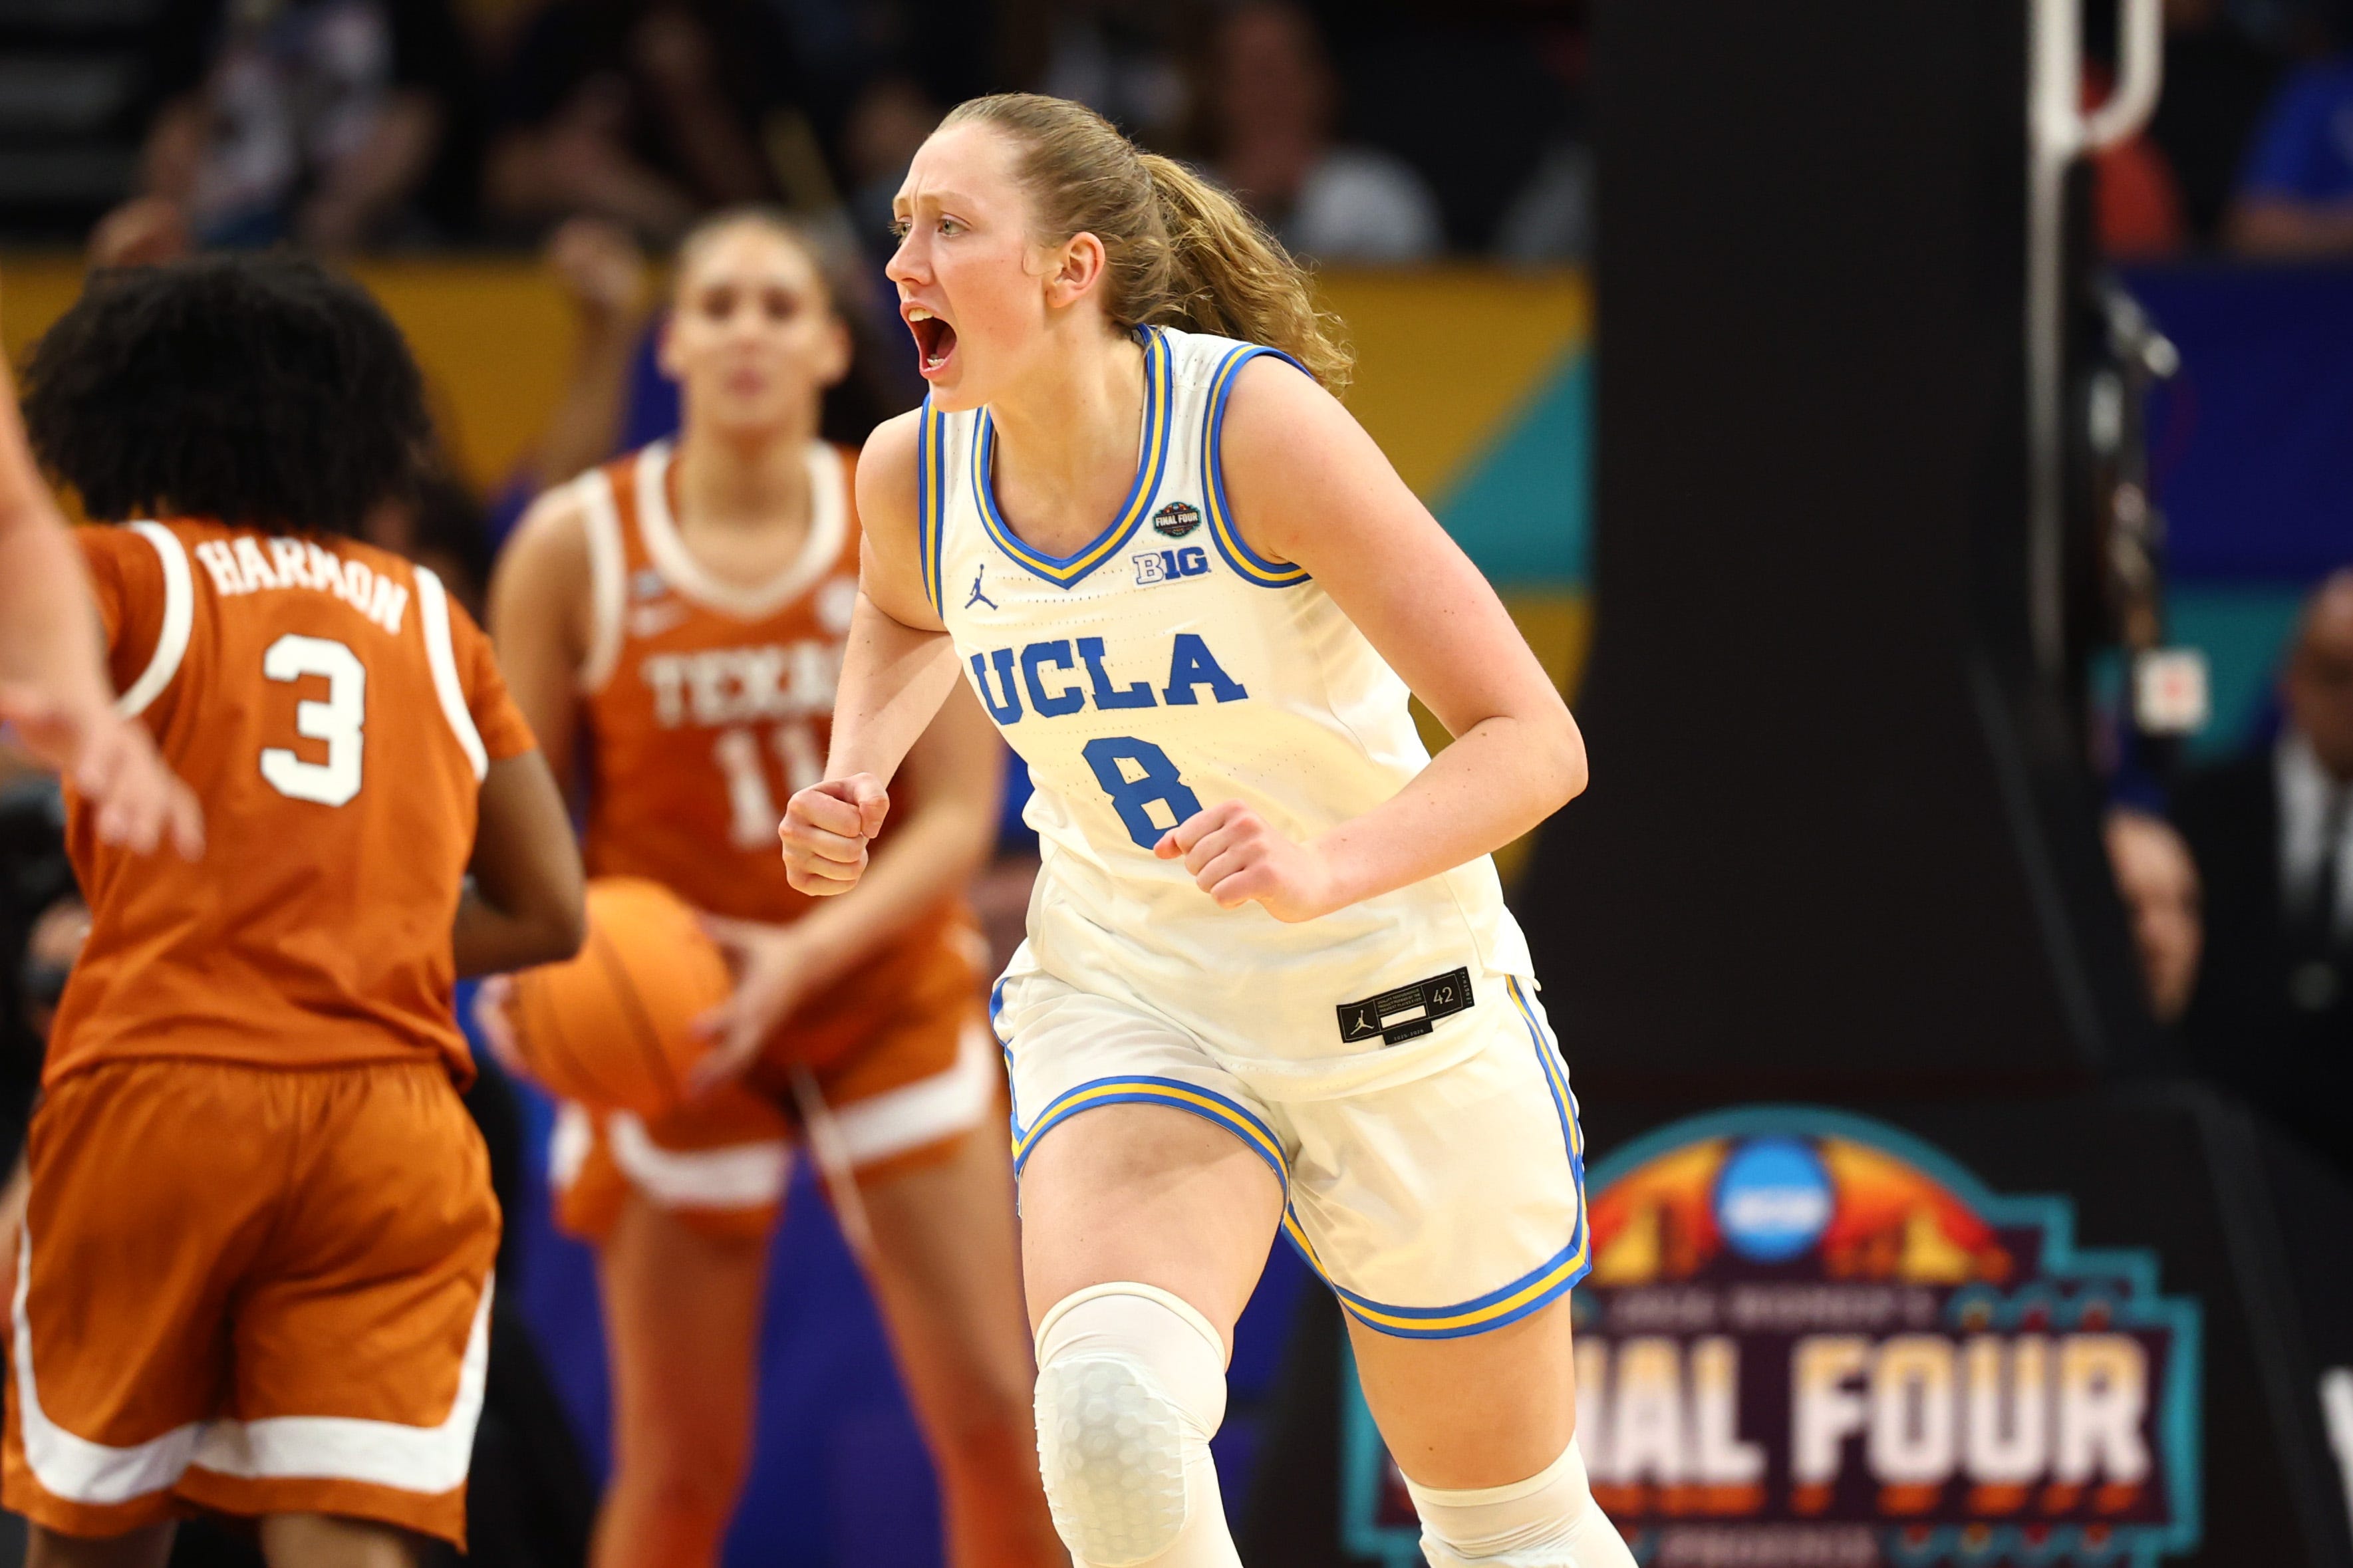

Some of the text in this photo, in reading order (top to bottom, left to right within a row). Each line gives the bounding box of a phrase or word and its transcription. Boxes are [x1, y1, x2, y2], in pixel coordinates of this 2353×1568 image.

[1155, 512, 1198, 527] FINAL FOUR
[195, 536, 408, 634] HARMON
[260, 634, 365, 807] 3
[644, 642, 843, 727] TEXA
[970, 634, 1248, 725] UCLA
[1081, 736, 1203, 850] 8
[1433, 986, 1454, 1005] 42
[1792, 1333, 2149, 1486] FOUR
